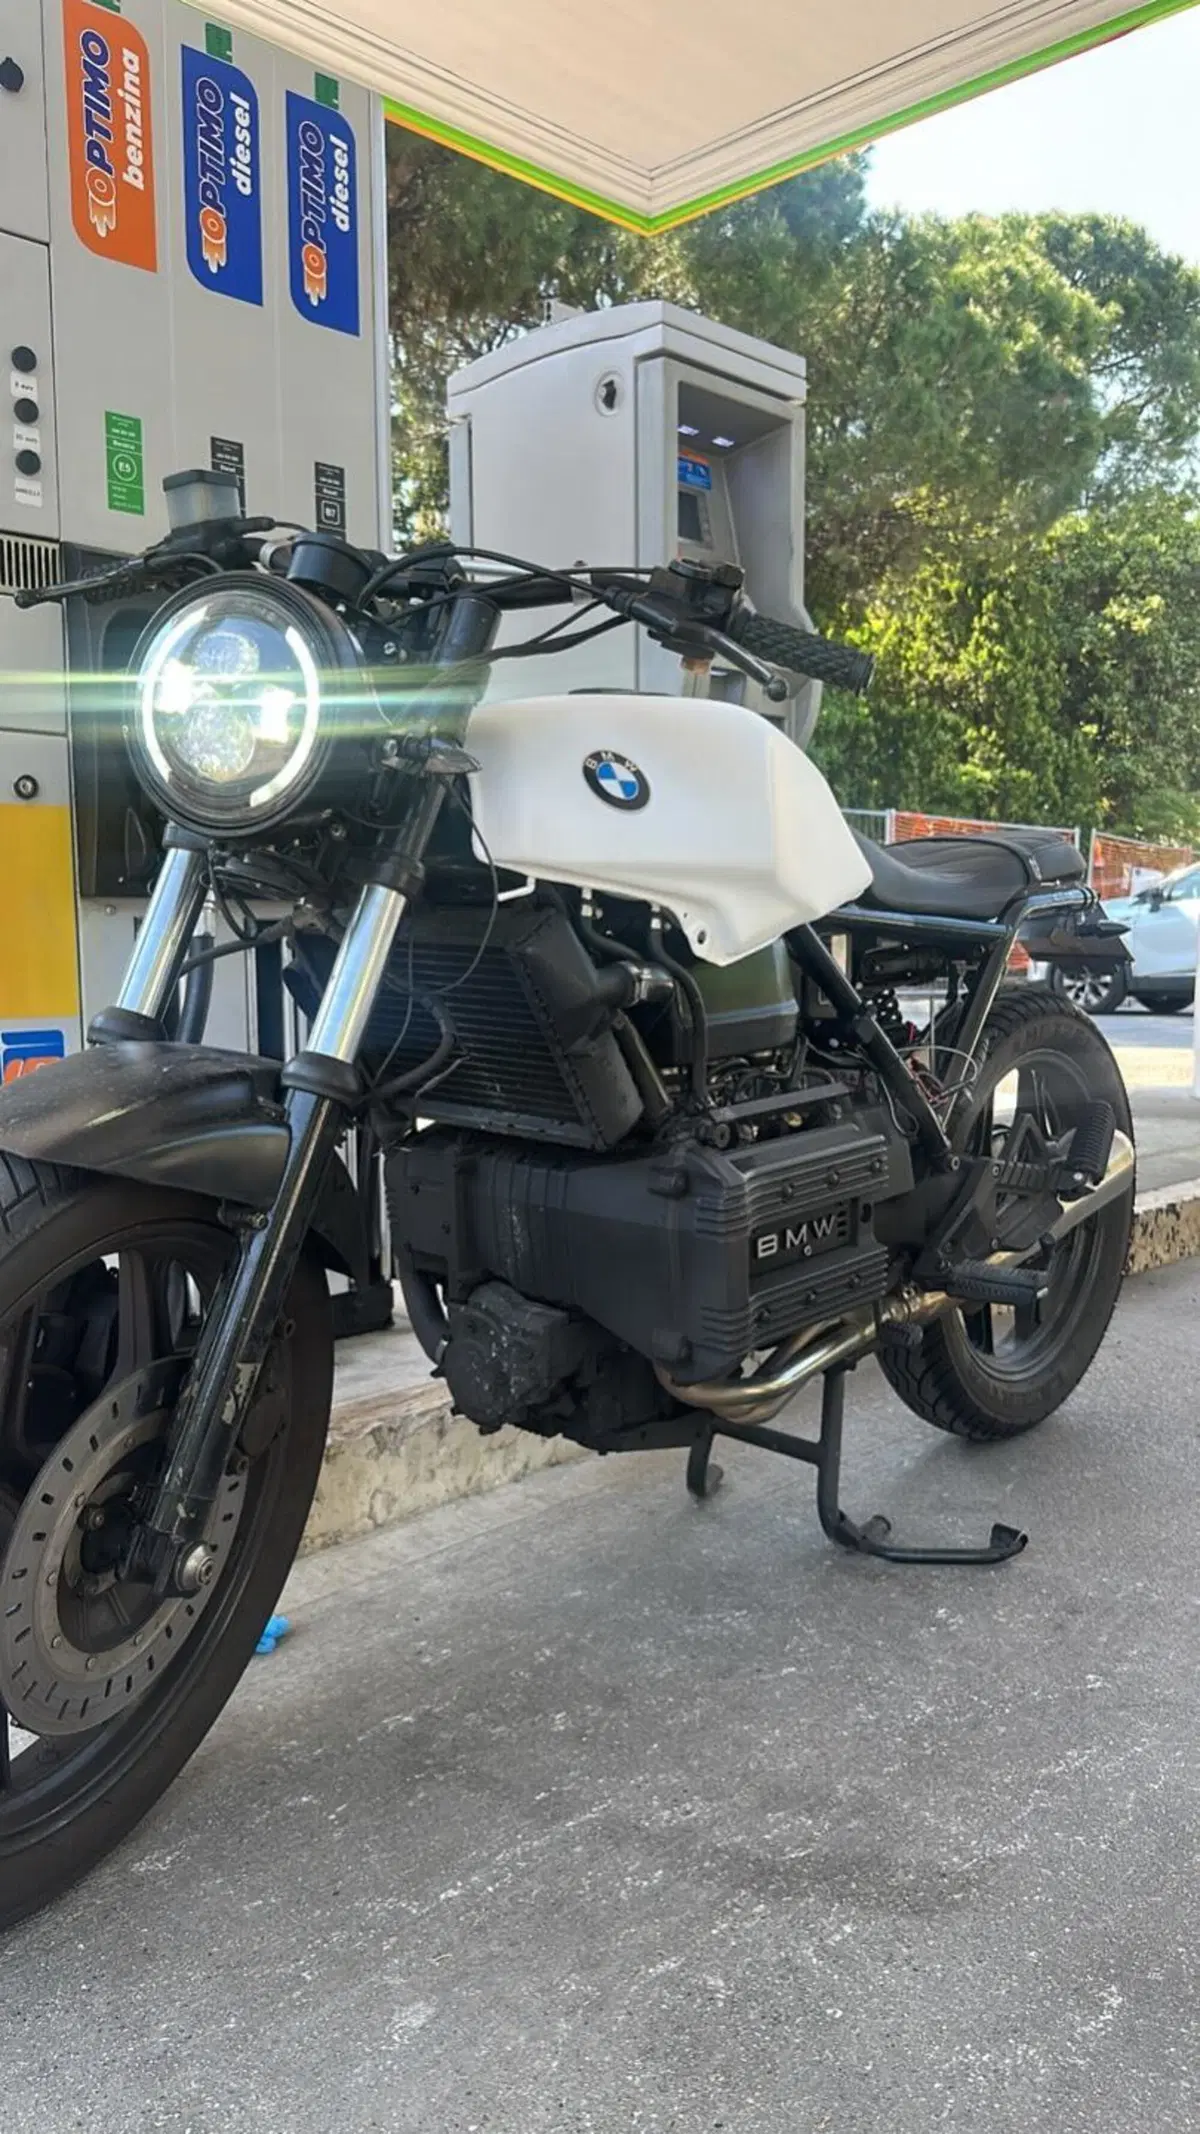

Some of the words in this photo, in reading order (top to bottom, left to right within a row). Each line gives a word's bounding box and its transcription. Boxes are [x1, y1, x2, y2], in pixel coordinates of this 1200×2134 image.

[80, 28, 116, 206] OPTIMO
[117, 47, 144, 191] benzina
[196, 77, 227, 244] OPTIMO
[229, 91, 252, 196] diesel
[299, 120, 327, 278] OPTIMO
[329, 133, 350, 232] diesel
[585, 751, 639, 772] BMW
[757, 1214, 836, 1259] BMW
